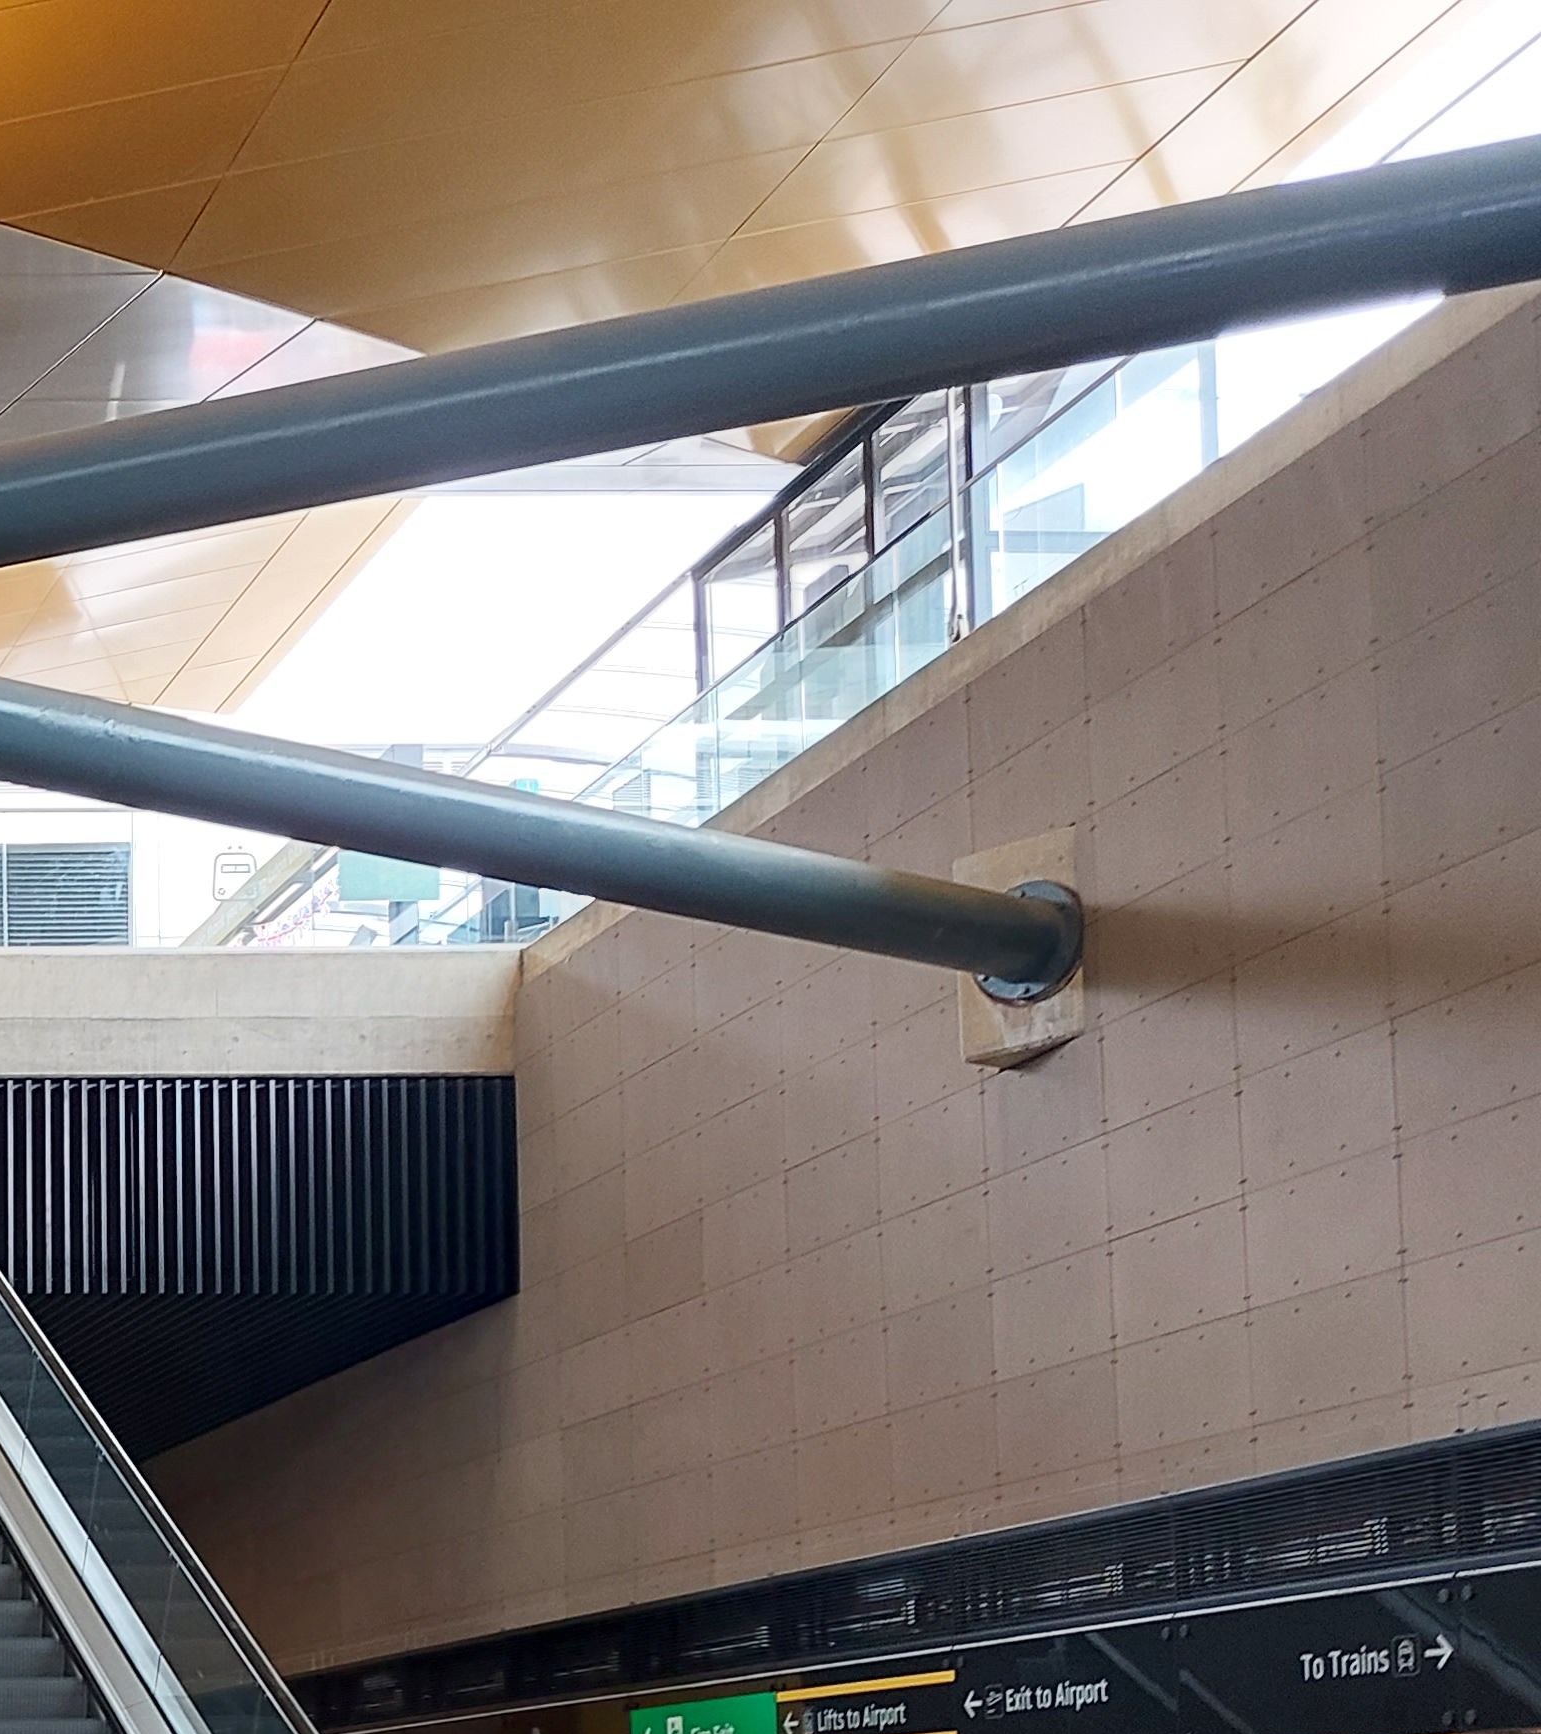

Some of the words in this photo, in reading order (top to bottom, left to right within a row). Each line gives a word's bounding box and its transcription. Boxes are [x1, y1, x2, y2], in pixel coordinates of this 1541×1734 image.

[1300, 1653, 1325, 1682] To
[1327, 1645, 1390, 1678] Trains
[1005, 1685, 1034, 1713] Exit
[1034, 1685, 1052, 1709] to
[1055, 1678, 1109, 1712] Airport
[817, 1708, 845, 1732] Lifts
[846, 1709, 861, 1729] to
[862, 1702, 907, 1732] Airport
